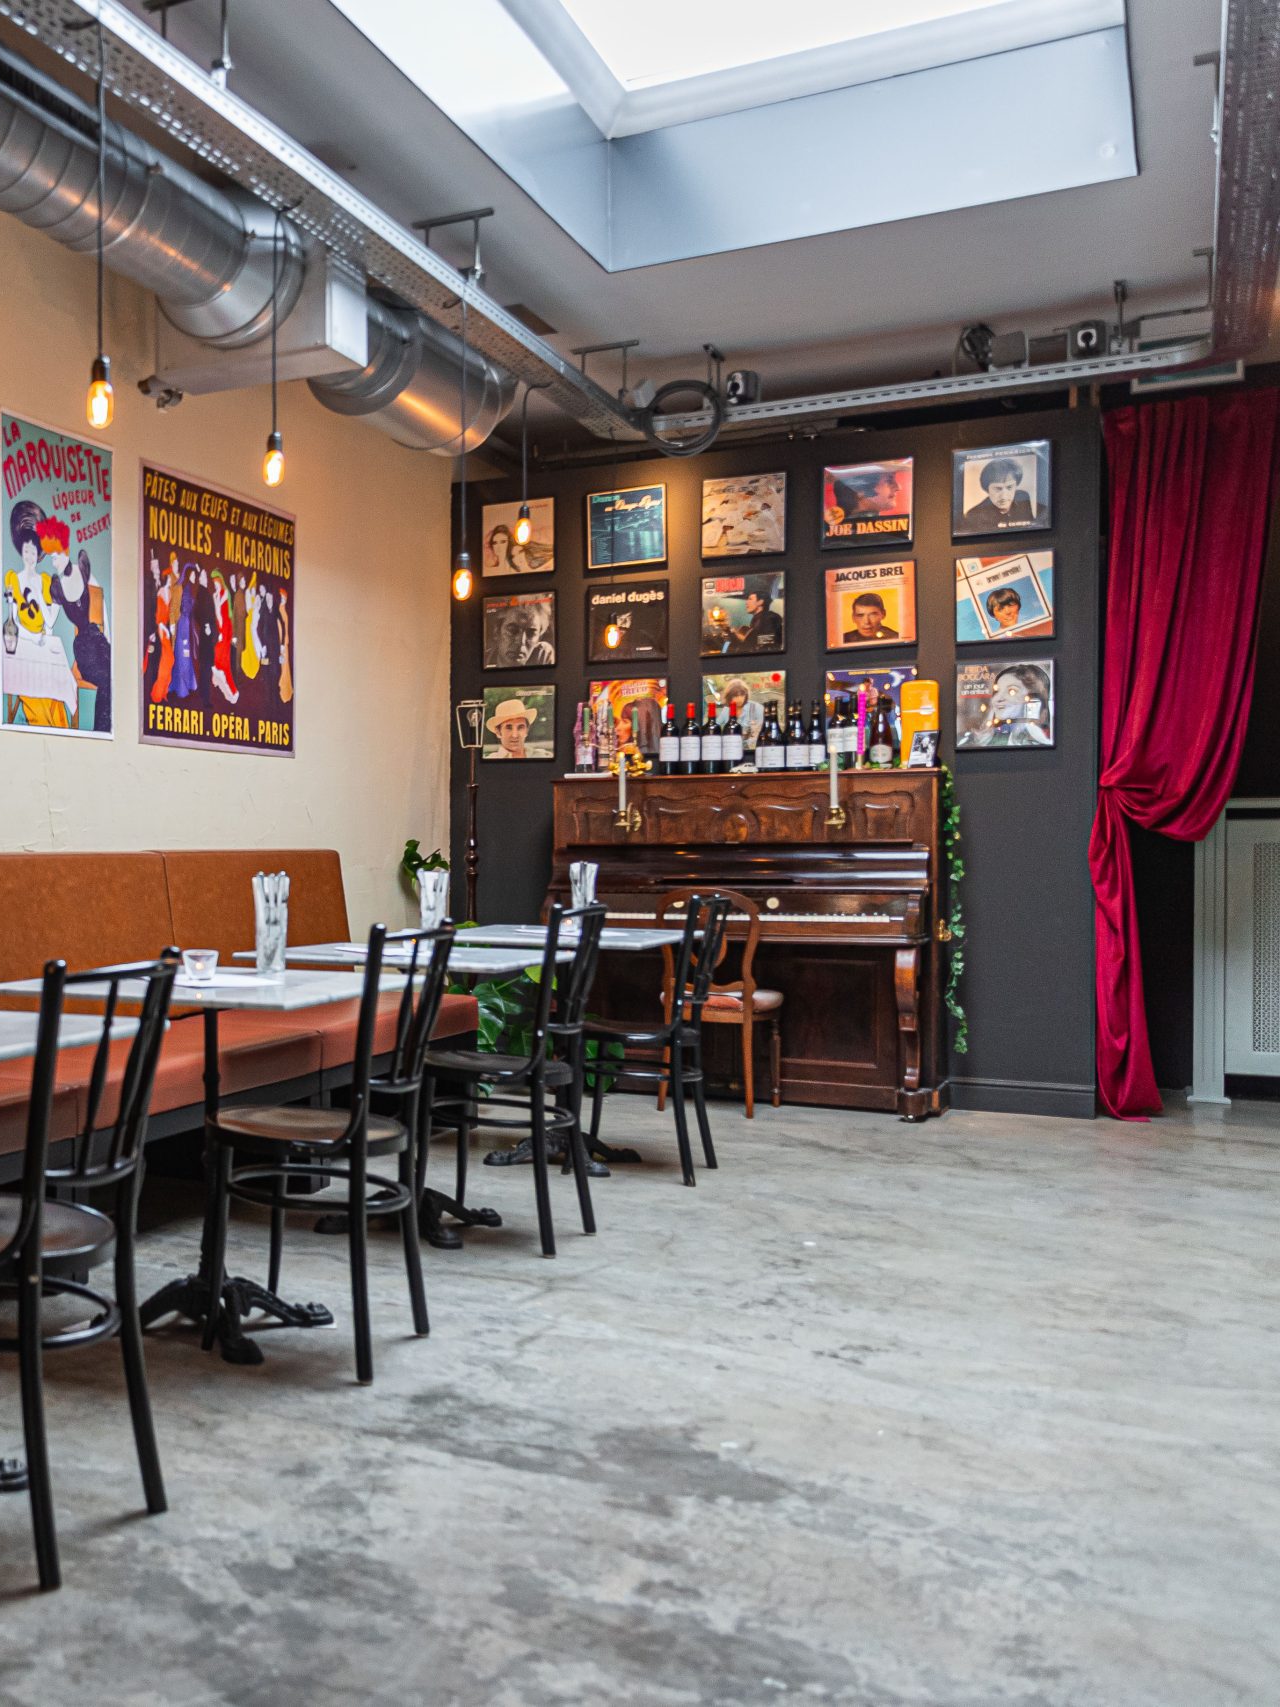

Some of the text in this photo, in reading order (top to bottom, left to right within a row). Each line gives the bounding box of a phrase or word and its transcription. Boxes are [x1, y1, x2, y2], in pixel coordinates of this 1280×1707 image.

[3, 420, 22, 448] LA
[51, 489, 97, 511] LIQUEUR
[144, 471, 177, 506] PÂTES
[180, 488, 198, 513] AUX
[231, 506, 240, 526] ET
[242, 511, 258, 533] AUX
[70, 511, 82, 523] DE
[75, 512, 111, 543] DESSERT
[826, 517, 909, 537] JOE DASSIN
[149, 505, 291, 580] NOUILLES MACARONIS
[834, 566, 905, 583] JACQUES BREL
[591, 589, 665, 606] daniel dugès
[148, 703, 204, 736] FERRARI
[258, 719, 290, 746] PARIS
